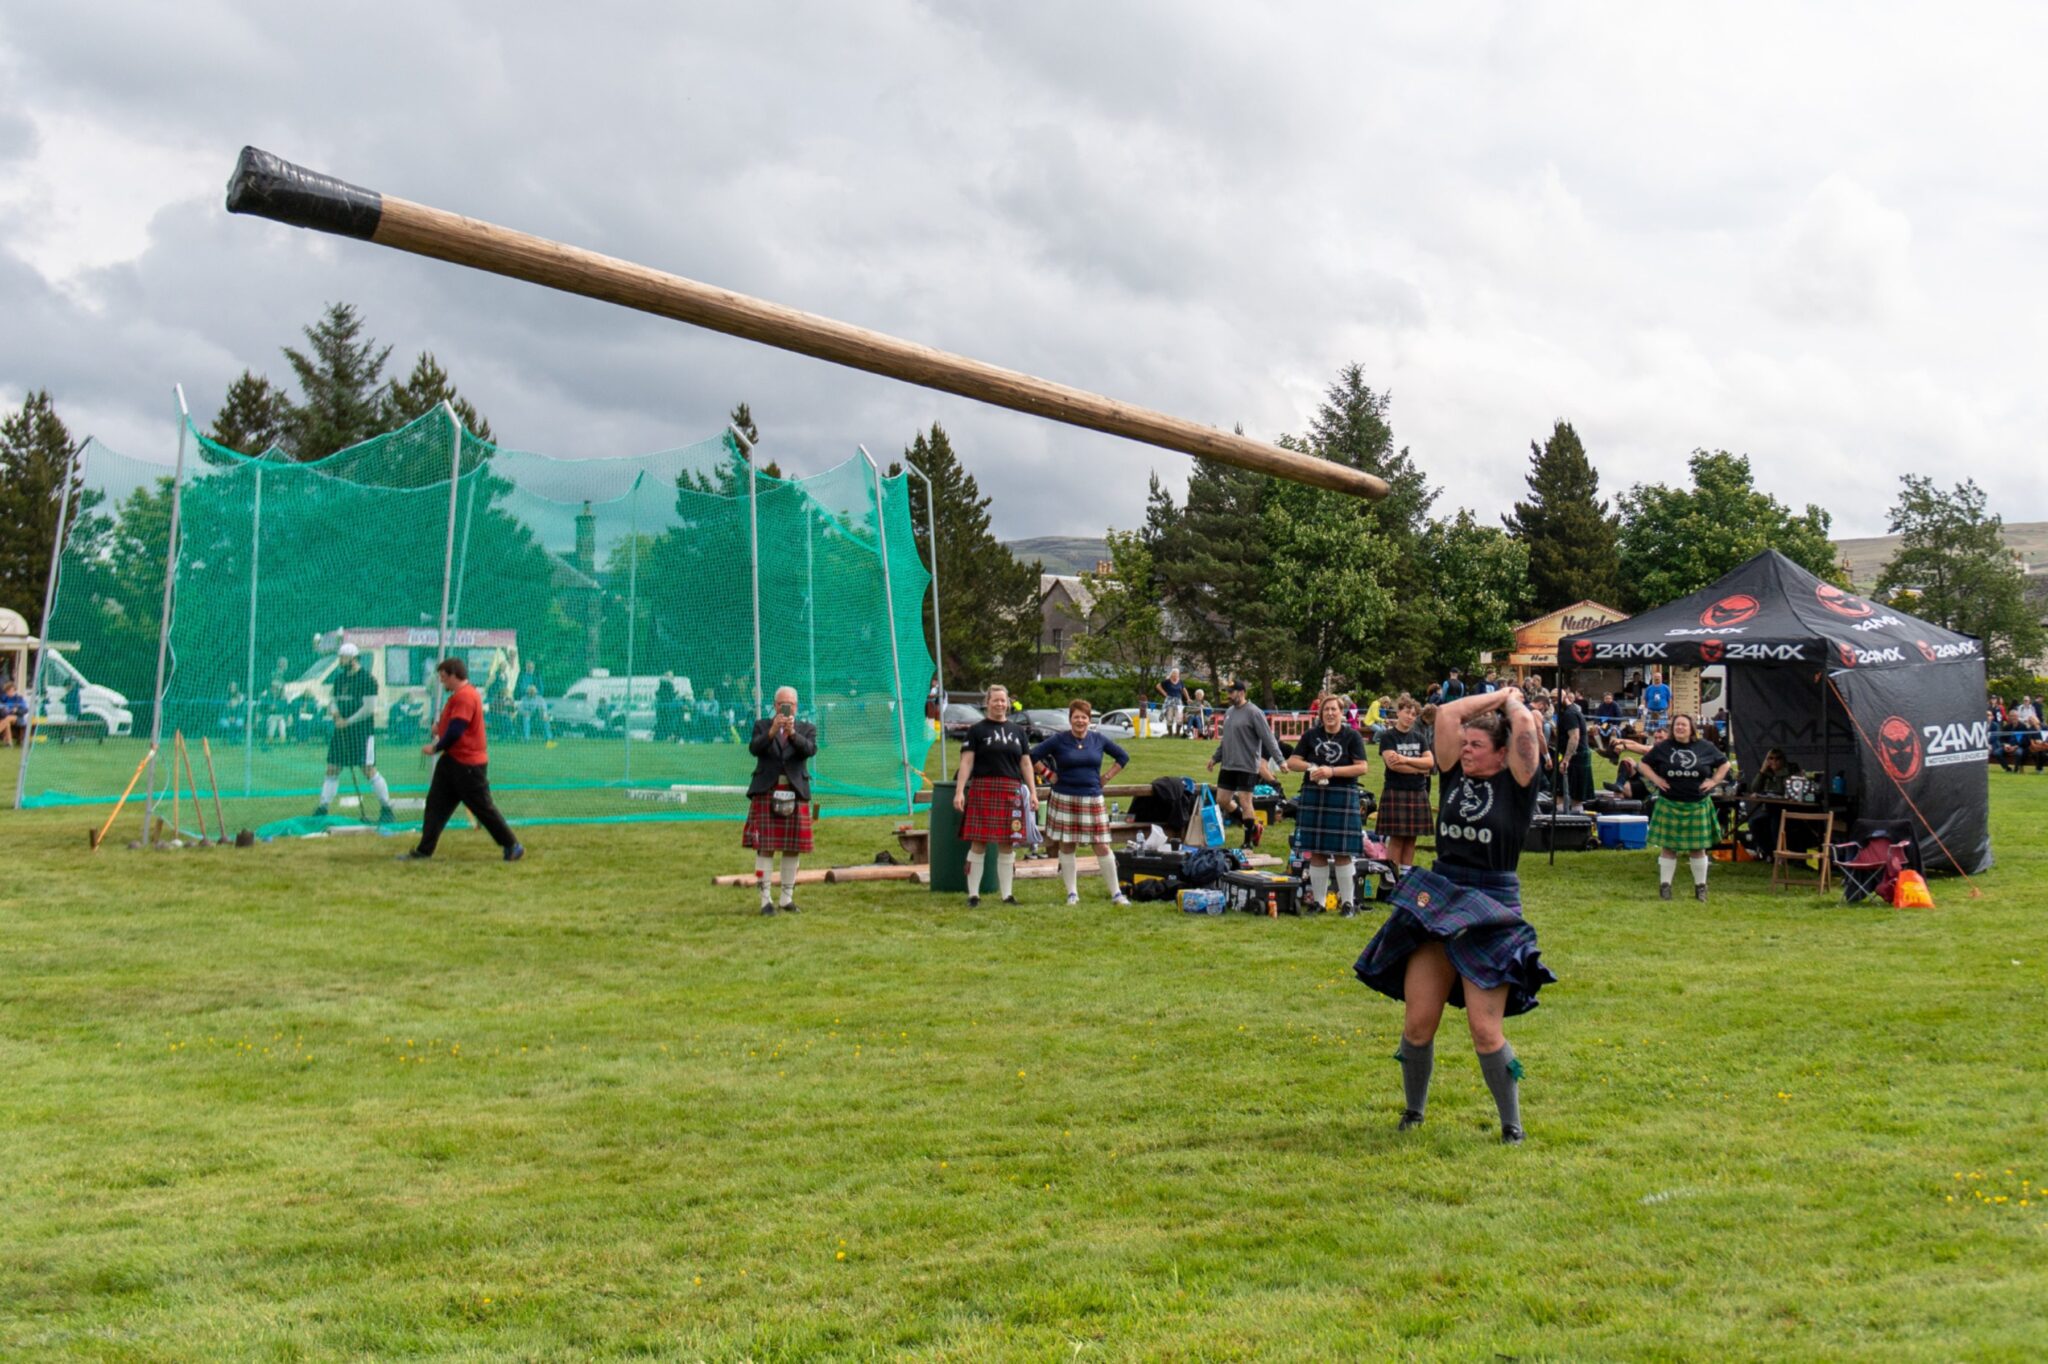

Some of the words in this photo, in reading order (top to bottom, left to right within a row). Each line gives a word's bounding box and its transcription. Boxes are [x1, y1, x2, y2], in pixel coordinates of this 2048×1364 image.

[1595, 643, 1668, 659] 24MX
[1725, 644, 1806, 660] 24MX
[1855, 646, 1906, 664] 24MX
[1932, 640, 1978, 658] 24MX
[1923, 721, 1989, 754] 24MX
